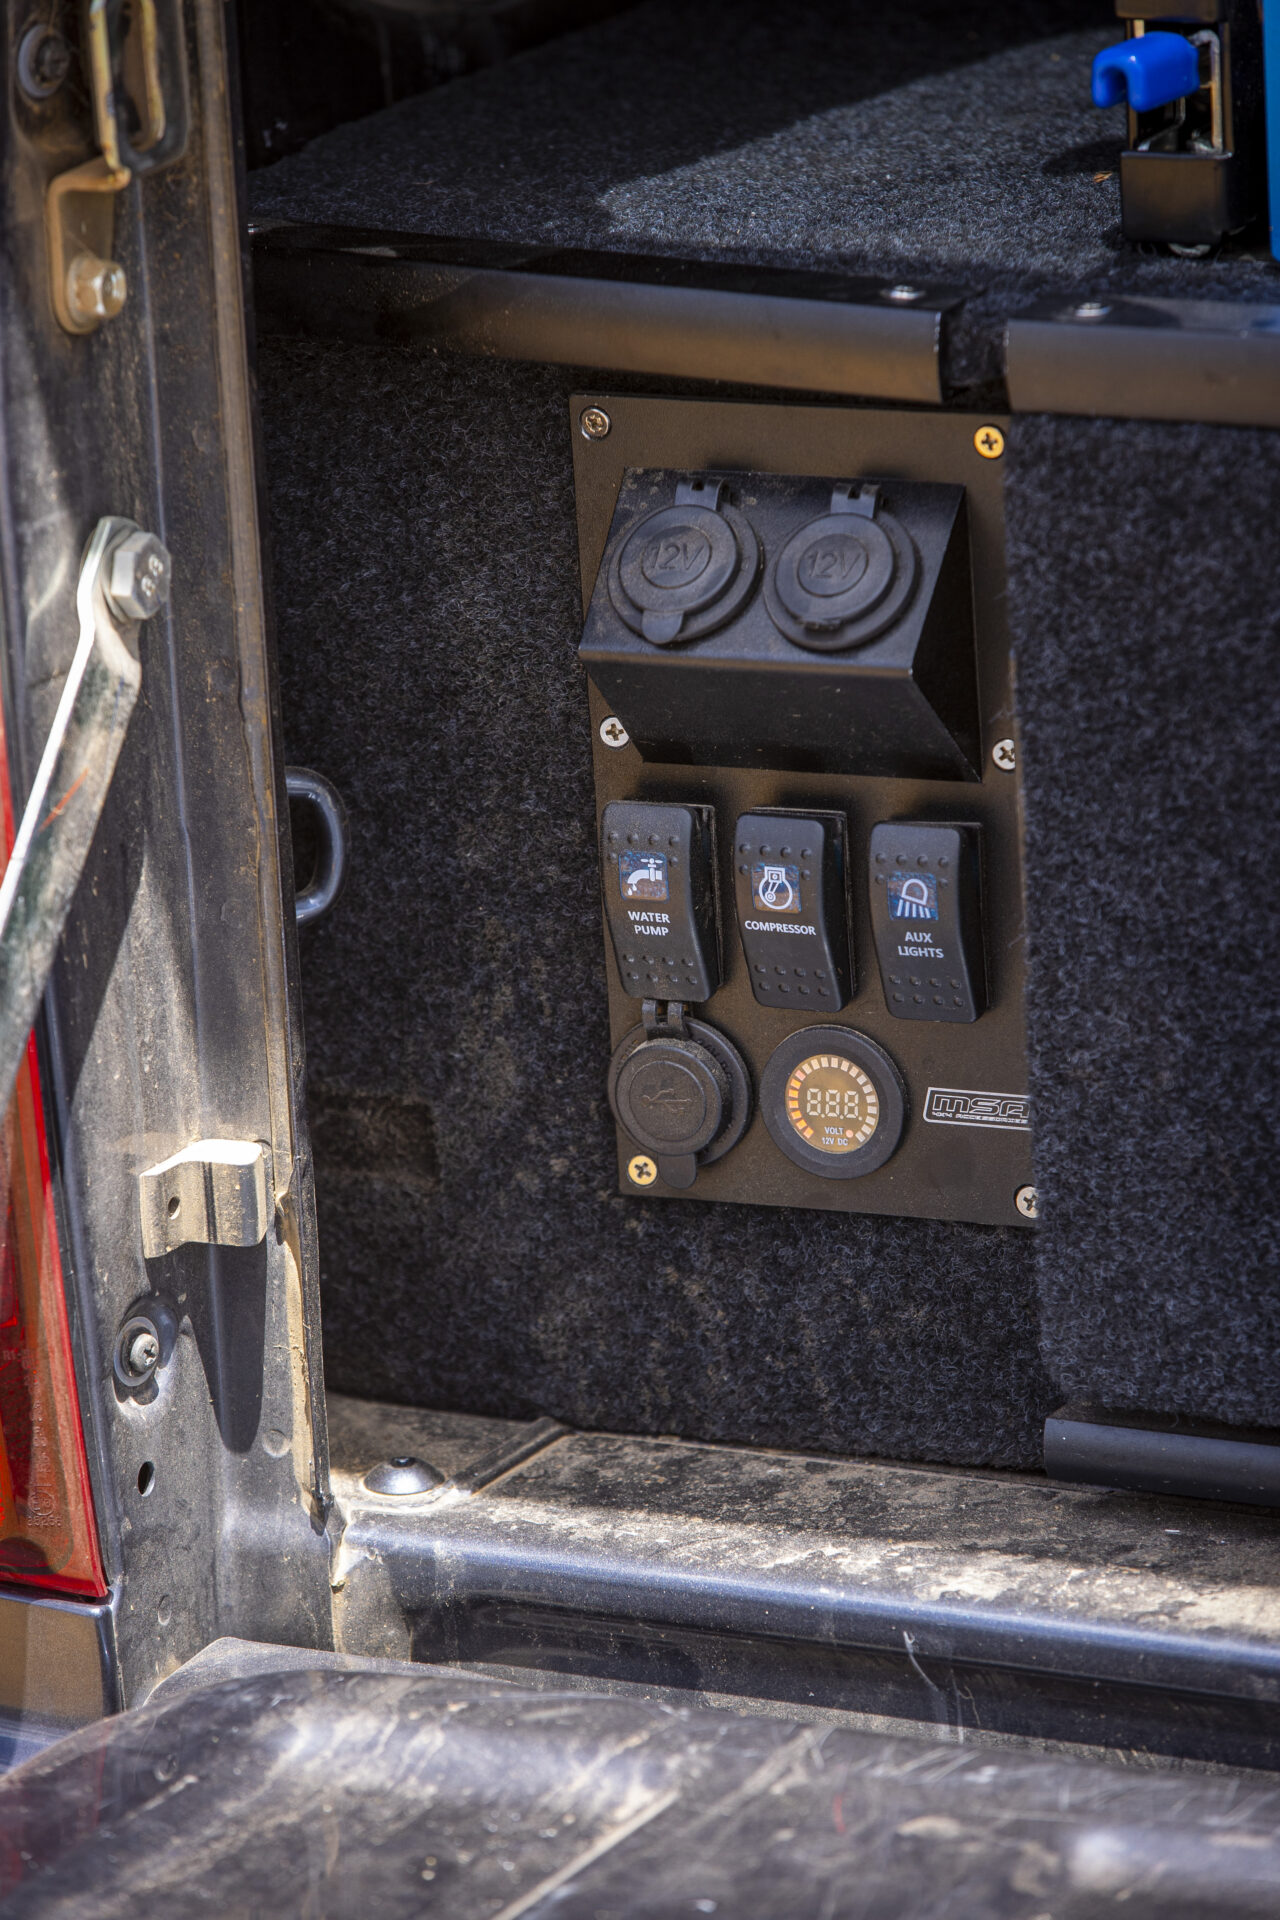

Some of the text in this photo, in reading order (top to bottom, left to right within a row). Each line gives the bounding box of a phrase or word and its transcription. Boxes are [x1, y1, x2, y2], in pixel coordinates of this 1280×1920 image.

[648, 542, 705, 571] 12V
[805, 551, 862, 580] 12V
[627, 910, 671, 924] WATER
[634, 924, 669, 936] PUMP
[744, 920, 817, 936] COMPRESSOR
[904, 931, 933, 943] AUX
[897, 945, 945, 959] LIGHTS
[824, 1126, 845, 1135] VOLT
[821, 1136, 849, 1146] 12V DC
